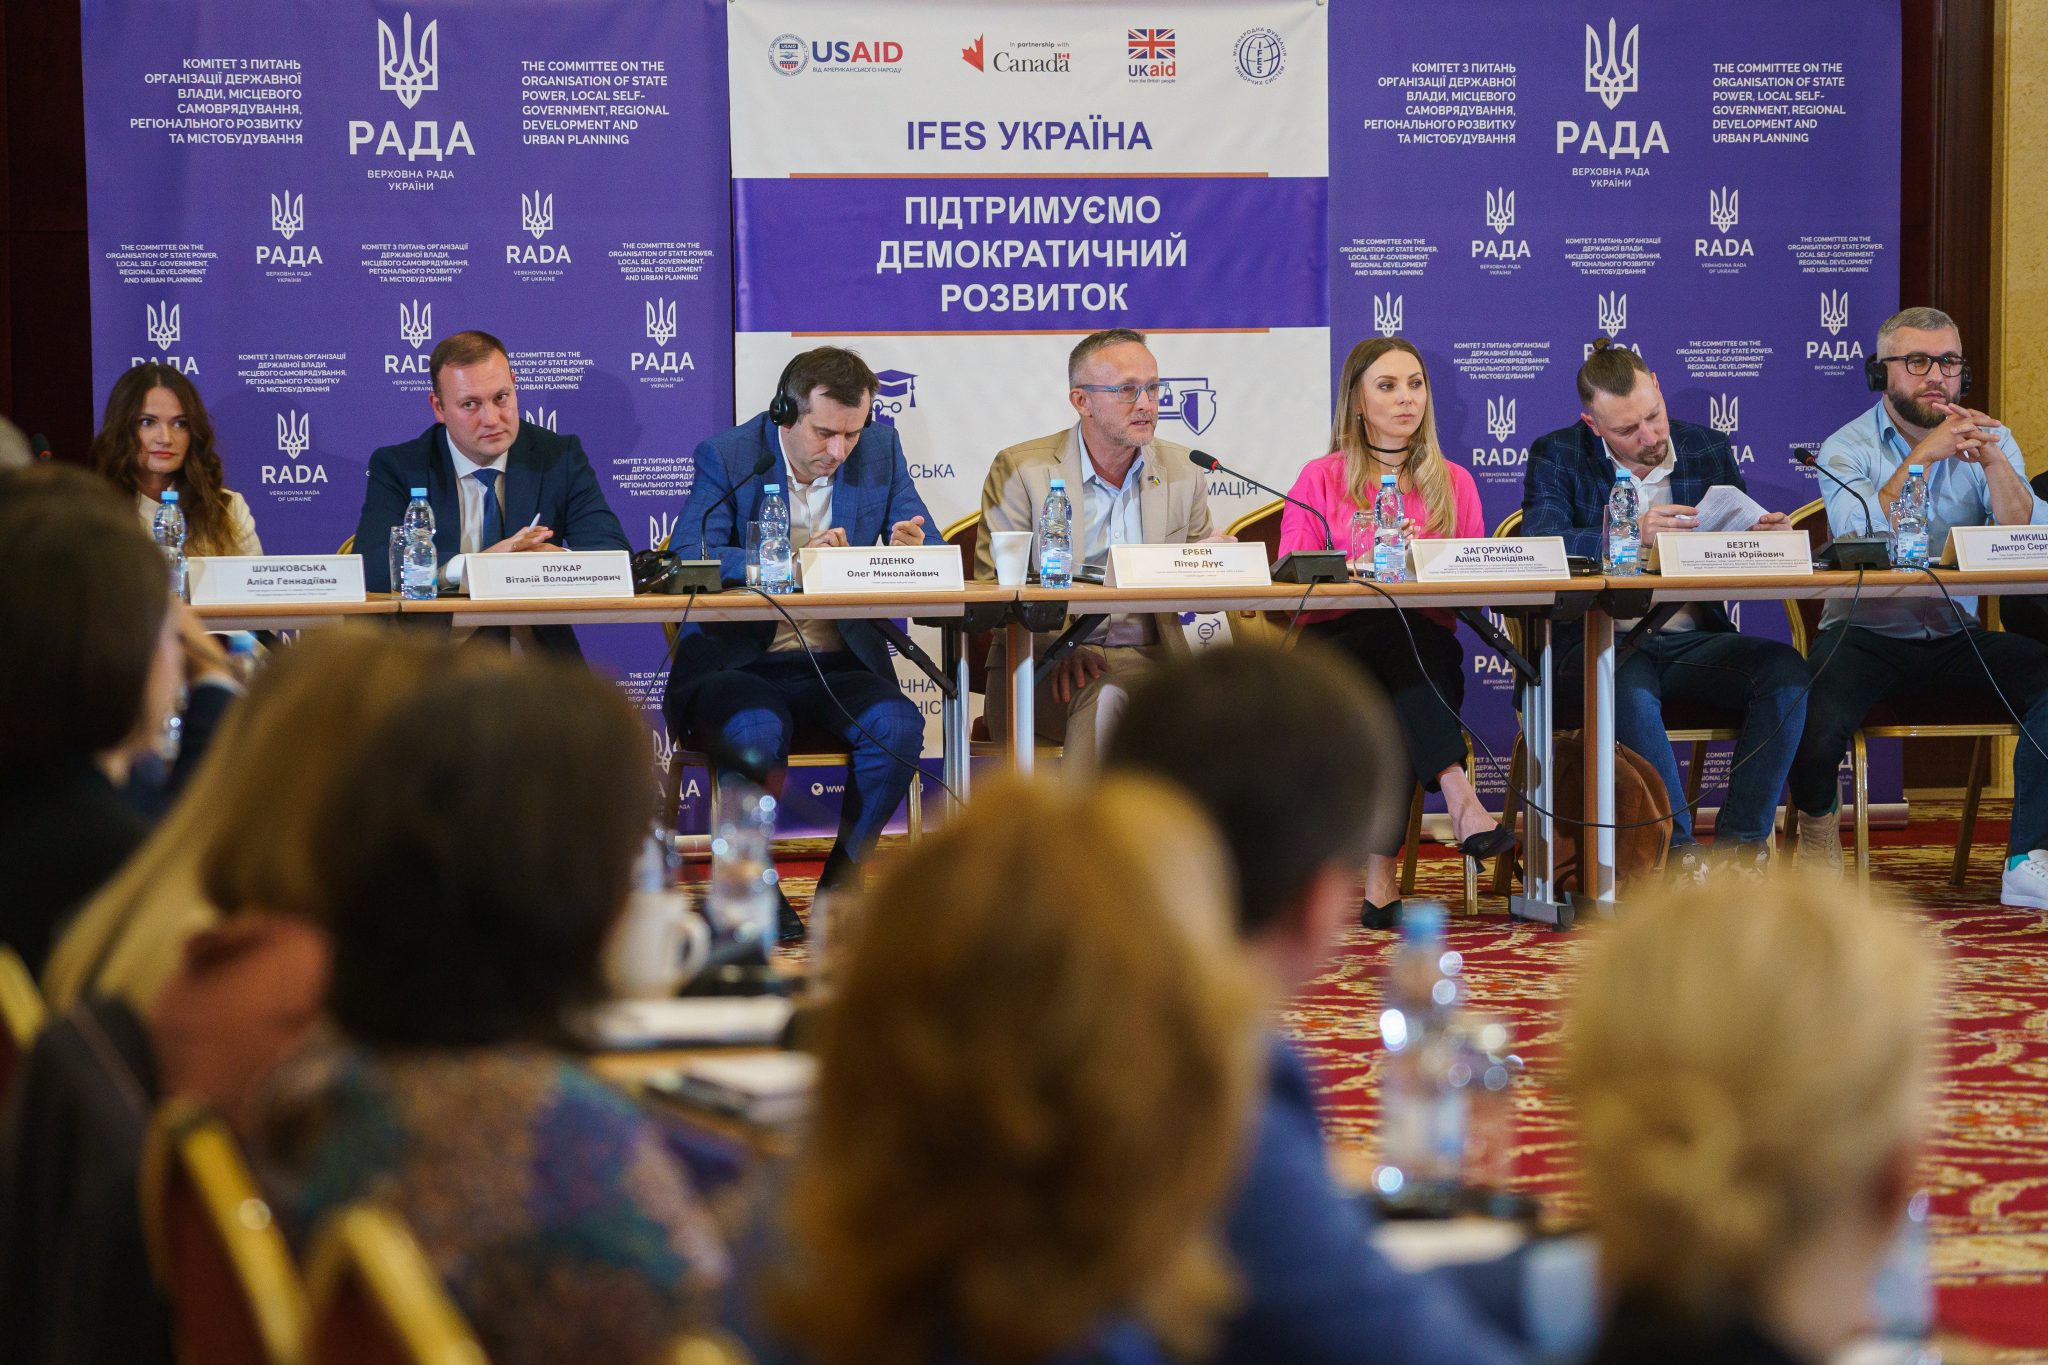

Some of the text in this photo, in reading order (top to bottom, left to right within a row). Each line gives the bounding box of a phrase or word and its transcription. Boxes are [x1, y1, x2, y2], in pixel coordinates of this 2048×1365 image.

[812, 41, 904, 63] USAID
[184, 59, 237, 69] КОМІТЕТ
[251, 60, 300, 70] ПИТАНЬ
[522, 61, 664, 72] THE COMMITTEE ON THE
[993, 51, 1071, 72] Canada
[1412, 63, 1460, 73] КОМІТЕТ
[1472, 64, 1516, 73] ПИТАНЬ
[1713, 63, 1842, 73] THE COMMITTEE ON THE
[145, 72, 301, 86] ОРГАНІЗАЦІЇ ДЕРЖАВНОЇ
[522, 76, 667, 87] ORGANISATION OF STATE
[1378, 75, 1516, 89] ОРГАНІЗАЦІЇ ДЕРЖАВНОЇ
[1713, 77, 1844, 87] ORGANISATION OF STATE
[178, 89, 302, 101] ВЛАДИ, МІСЦЕВОГО
[523, 91, 645, 102] POWER, LOCAL SELF-
[1407, 92, 1516, 103] ВЛАДИ, МІСЦЕВОГО
[1713, 91, 1824, 102] POWER, LOCAL SELF-
[178, 104, 302, 116] САМОВРЯДУВАННЯ,
[523, 105, 669, 117] GOVERNMENT, REGIONAL
[1406, 106, 1515, 117] САМОВРЯДУВАННЯ,
[1713, 105, 1846, 116] GOVERNMENT, REGIONAL
[131, 119, 302, 129] РЕГІОНАЛЬНОГО РОЗВИТКУ
[523, 120, 638, 131] DEVELOPMENT AND
[1365, 120, 1516, 130] РЕГІОНАЛЬНОГО РОЗВИТКУ
[1713, 119, 1817, 129] DEVELOPMENT AND
[908, 114, 1152, 150] IFES УКРАЇНА
[169, 134, 302, 146] ТА МІСТОБУДУВАННЯ
[349, 121, 475, 161] РАДА
[524, 135, 629, 145] URBAN PLANNING
[1398, 134, 1515, 145] ТА МІСТОБУДУВАННЯ
[1557, 121, 1669, 159] РАДА
[1713, 133, 1808, 144] URBAN PLANNING
[368, 170, 454, 180] ВЕРХОВНА РАДА
[1572, 168, 1650, 177] ВЕРХОВНА РАДА
[389, 180, 433, 191] УКРАЇНИ
[1591, 178, 1631, 188] УКРАЇНИ
[906, 196, 1160, 230] ПІДТРИМУЄМО
[877, 232, 1186, 274] ДЕМОКРАТИЧНИЙ
[1472, 240, 1530, 260] РАДА
[1696, 239, 1754, 256] RADA
[257, 246, 322, 267] РАДА
[507, 245, 571, 263] RADA
[655, 265, 702, 273] DEVELOPMENT
[665, 273, 698, 281] PLANNING
[942, 283, 1128, 312] РОЗВИТОК
[1807, 341, 1863, 361] РАДА
[384, 355, 431, 373] RAD
[632, 352, 694, 373] РАДА
[1473, 448, 1528, 465] RADA
[262, 465, 328, 483] RADA
[909, 464, 955, 478] СЬКА
[1208, 481, 1258, 499] МАЦІЯ
[1463, 545, 1523, 555] ЗАГОРУЙКО
[1726, 541, 1760, 549] БЕЗГІН
[1991, 542, 2048, 553] Дмитро Серг
[1454, 554, 1535, 564] Аліна Леонідівна
[1704, 550, 1785, 560] Віталій Юрійович
[869, 557, 915, 566] ДІДЕНКО
[1174, 560, 1224, 568] Пітер Дуус
[252, 564, 327, 573] ШУШКОВСЬКА
[542, 565, 582, 573] ПЛУКАР
[847, 569, 939, 578] Олег Миколайович
[246, 577, 337, 587] Аліса Геннадіївна
[505, 575, 621, 584] Віталій Володимирович
[1474, 655, 1513, 676] РАД
[901, 679, 936, 693] ЧНА
